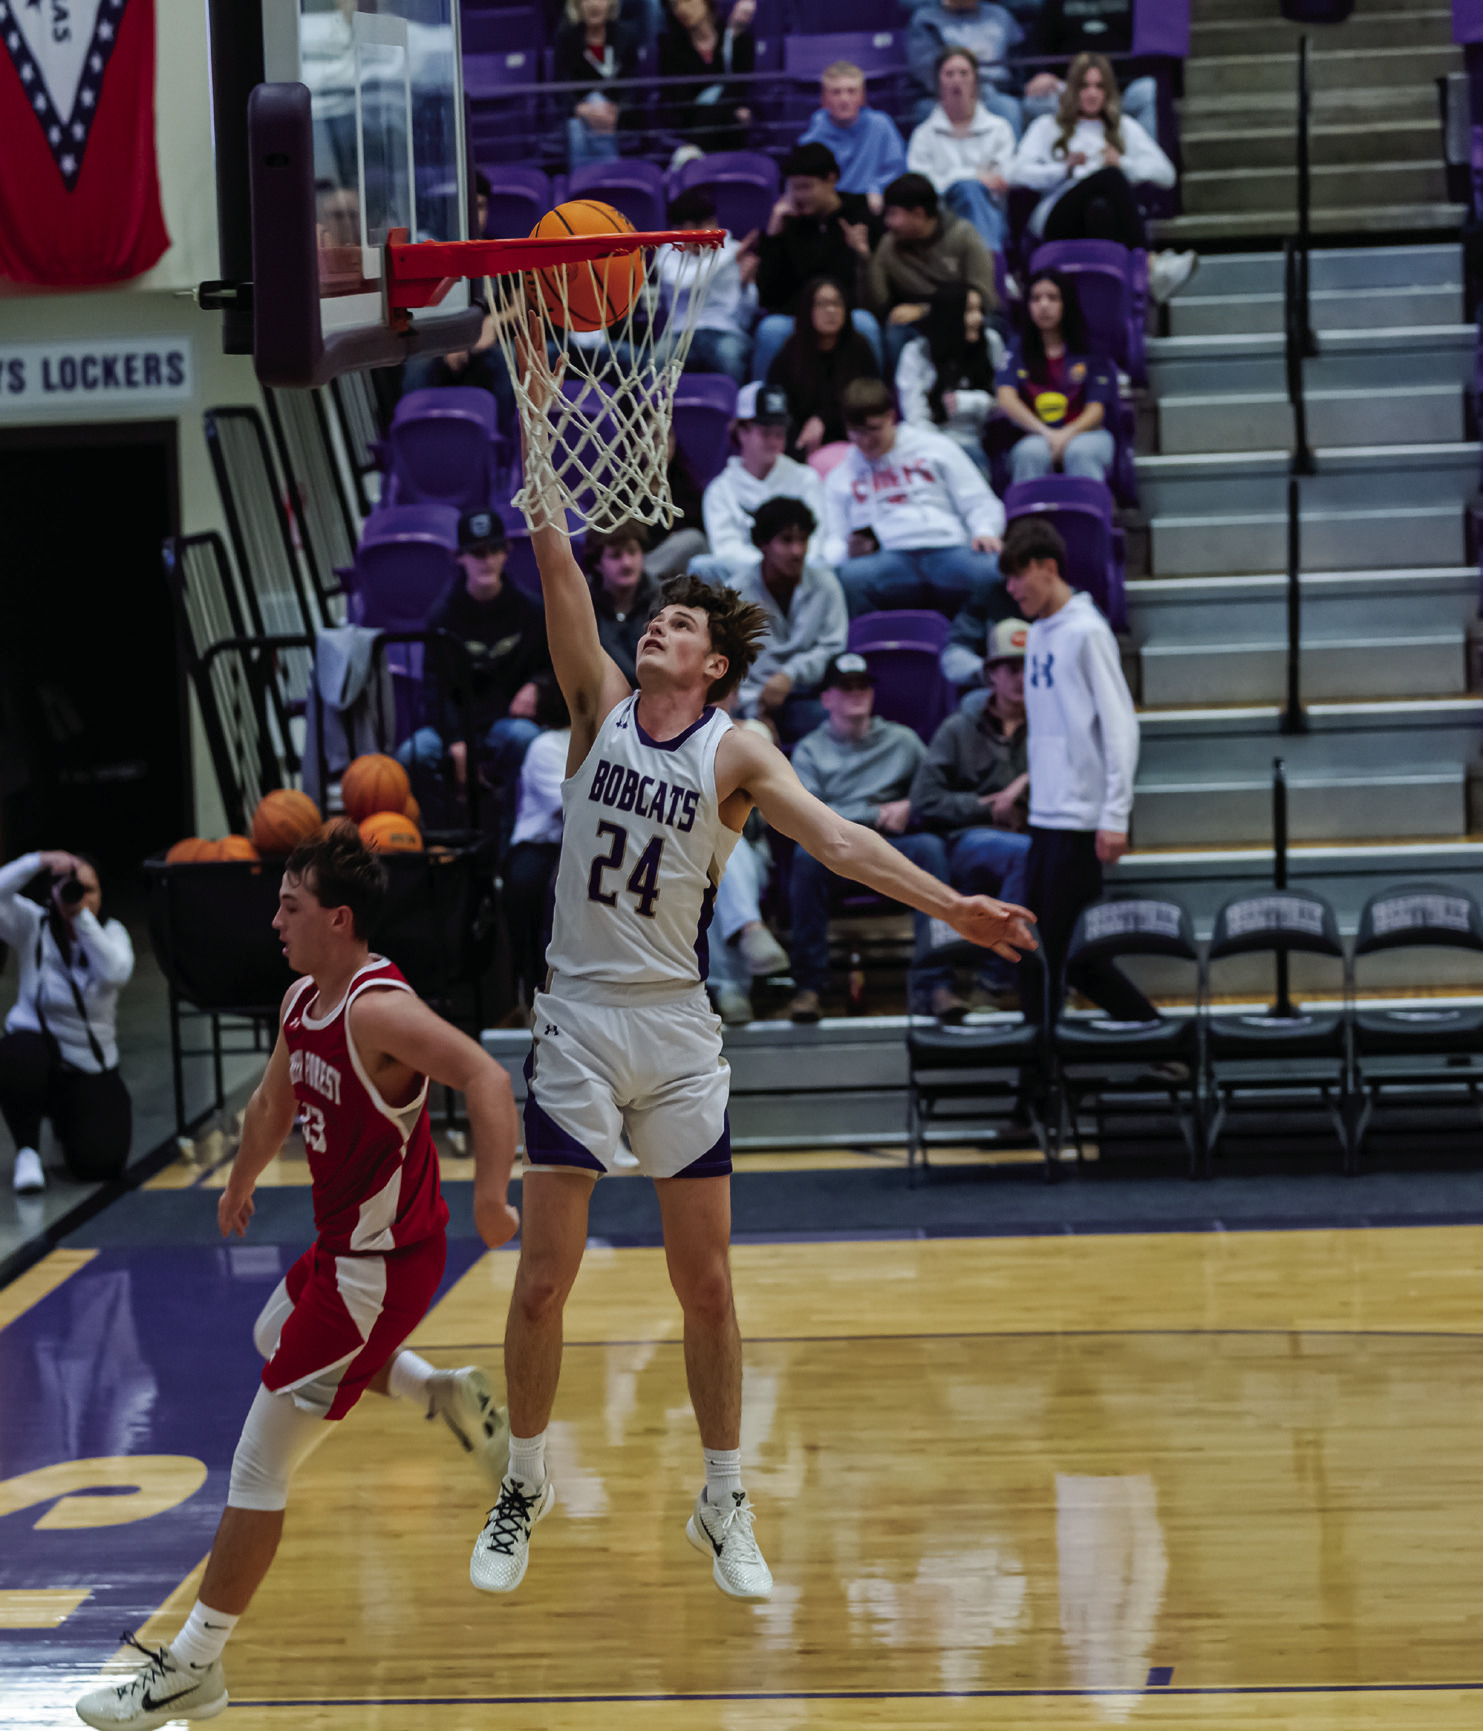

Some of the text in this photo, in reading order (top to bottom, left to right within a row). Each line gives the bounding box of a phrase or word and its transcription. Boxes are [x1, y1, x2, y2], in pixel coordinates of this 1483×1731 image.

[42, 350, 184, 393] LOCKERS
[588, 759, 701, 833] BOBCATS
[587, 818, 665, 919] 24
